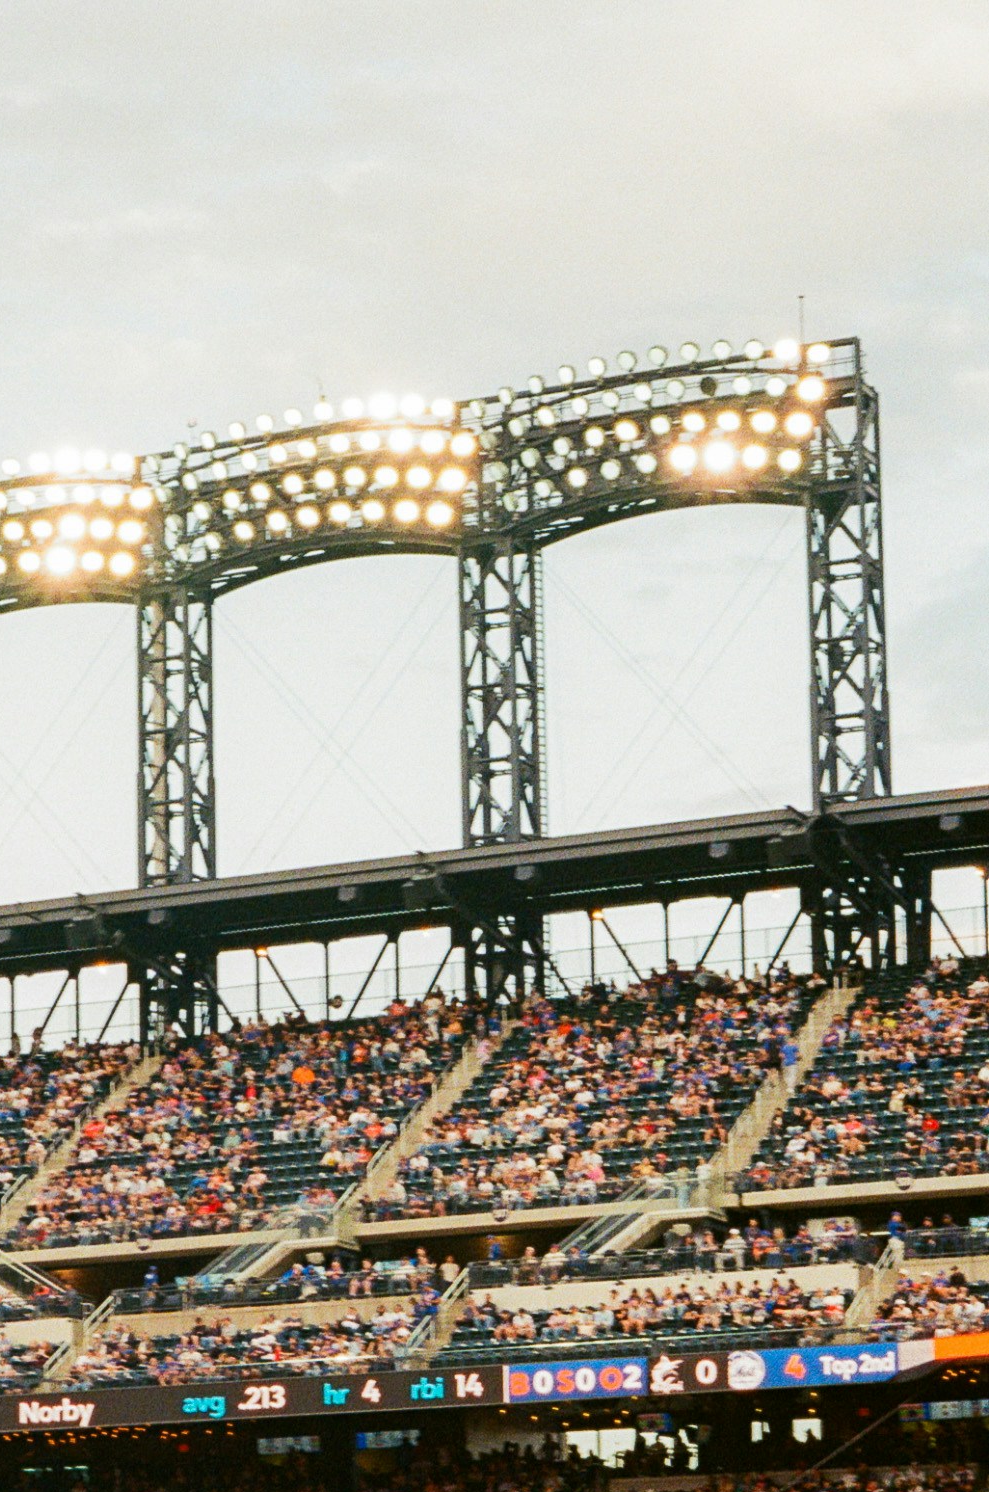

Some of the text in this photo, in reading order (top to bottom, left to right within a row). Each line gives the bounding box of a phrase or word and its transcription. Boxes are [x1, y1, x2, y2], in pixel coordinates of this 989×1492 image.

[509, 1372, 530, 1395] B
[531, 1369, 554, 1394] 0
[575, 1367, 597, 1393] 0
[622, 1364, 643, 1390] 2
[695, 1359, 718, 1384] 0
[783, 1354, 807, 1379] 4
[818, 1355, 858, 1381] Top
[859, 1351, 895, 1374] 2nd
[18, 1397, 95, 1427] Norby
[182, 1396, 226, 1419] avg
[237, 1385, 287, 1410] .213
[323, 1382, 350, 1405] hr
[361, 1379, 382, 1403] 4
[411, 1376, 444, 1400] rbi
[454, 1373, 484, 1398] 14
